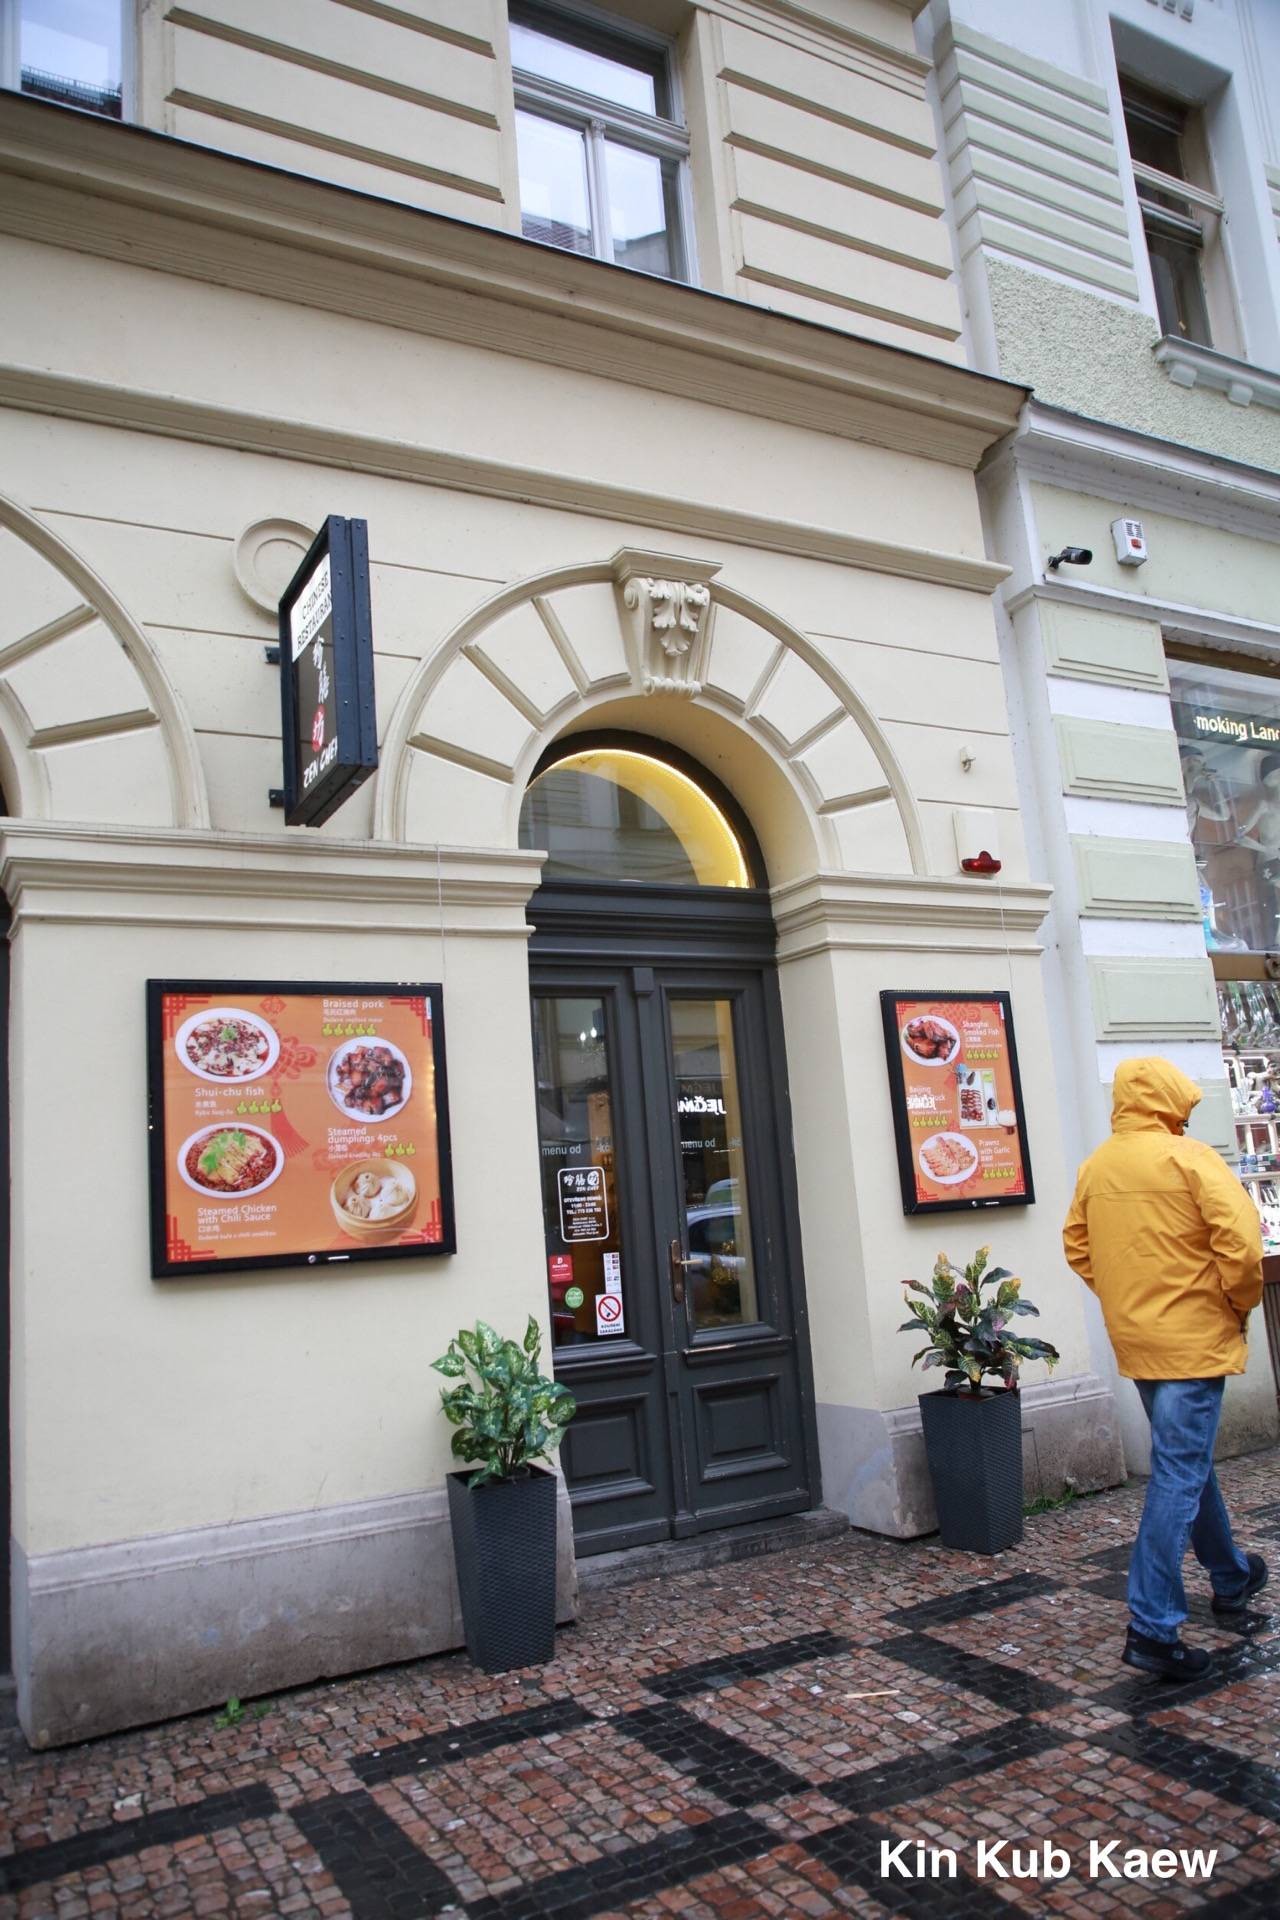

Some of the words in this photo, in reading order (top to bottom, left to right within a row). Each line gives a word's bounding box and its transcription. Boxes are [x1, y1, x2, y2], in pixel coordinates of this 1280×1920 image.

[302, 571, 329, 620] CHINESE
[1193, 715, 1249, 742] moking
[303, 757, 319, 789] ZEN
[322, 999, 359, 1008] Braised
[361, 999, 385, 1010] pork
[245, 1086, 265, 1096] fish
[327, 1127, 367, 1136] Steamed
[705, 1138, 716, 1148] od
[542, 1146, 567, 1156] menu
[569, 1144, 582, 1154] od
[197, 1206, 239, 1216] Steamed
[240, 1203, 278, 1215] Chicken
